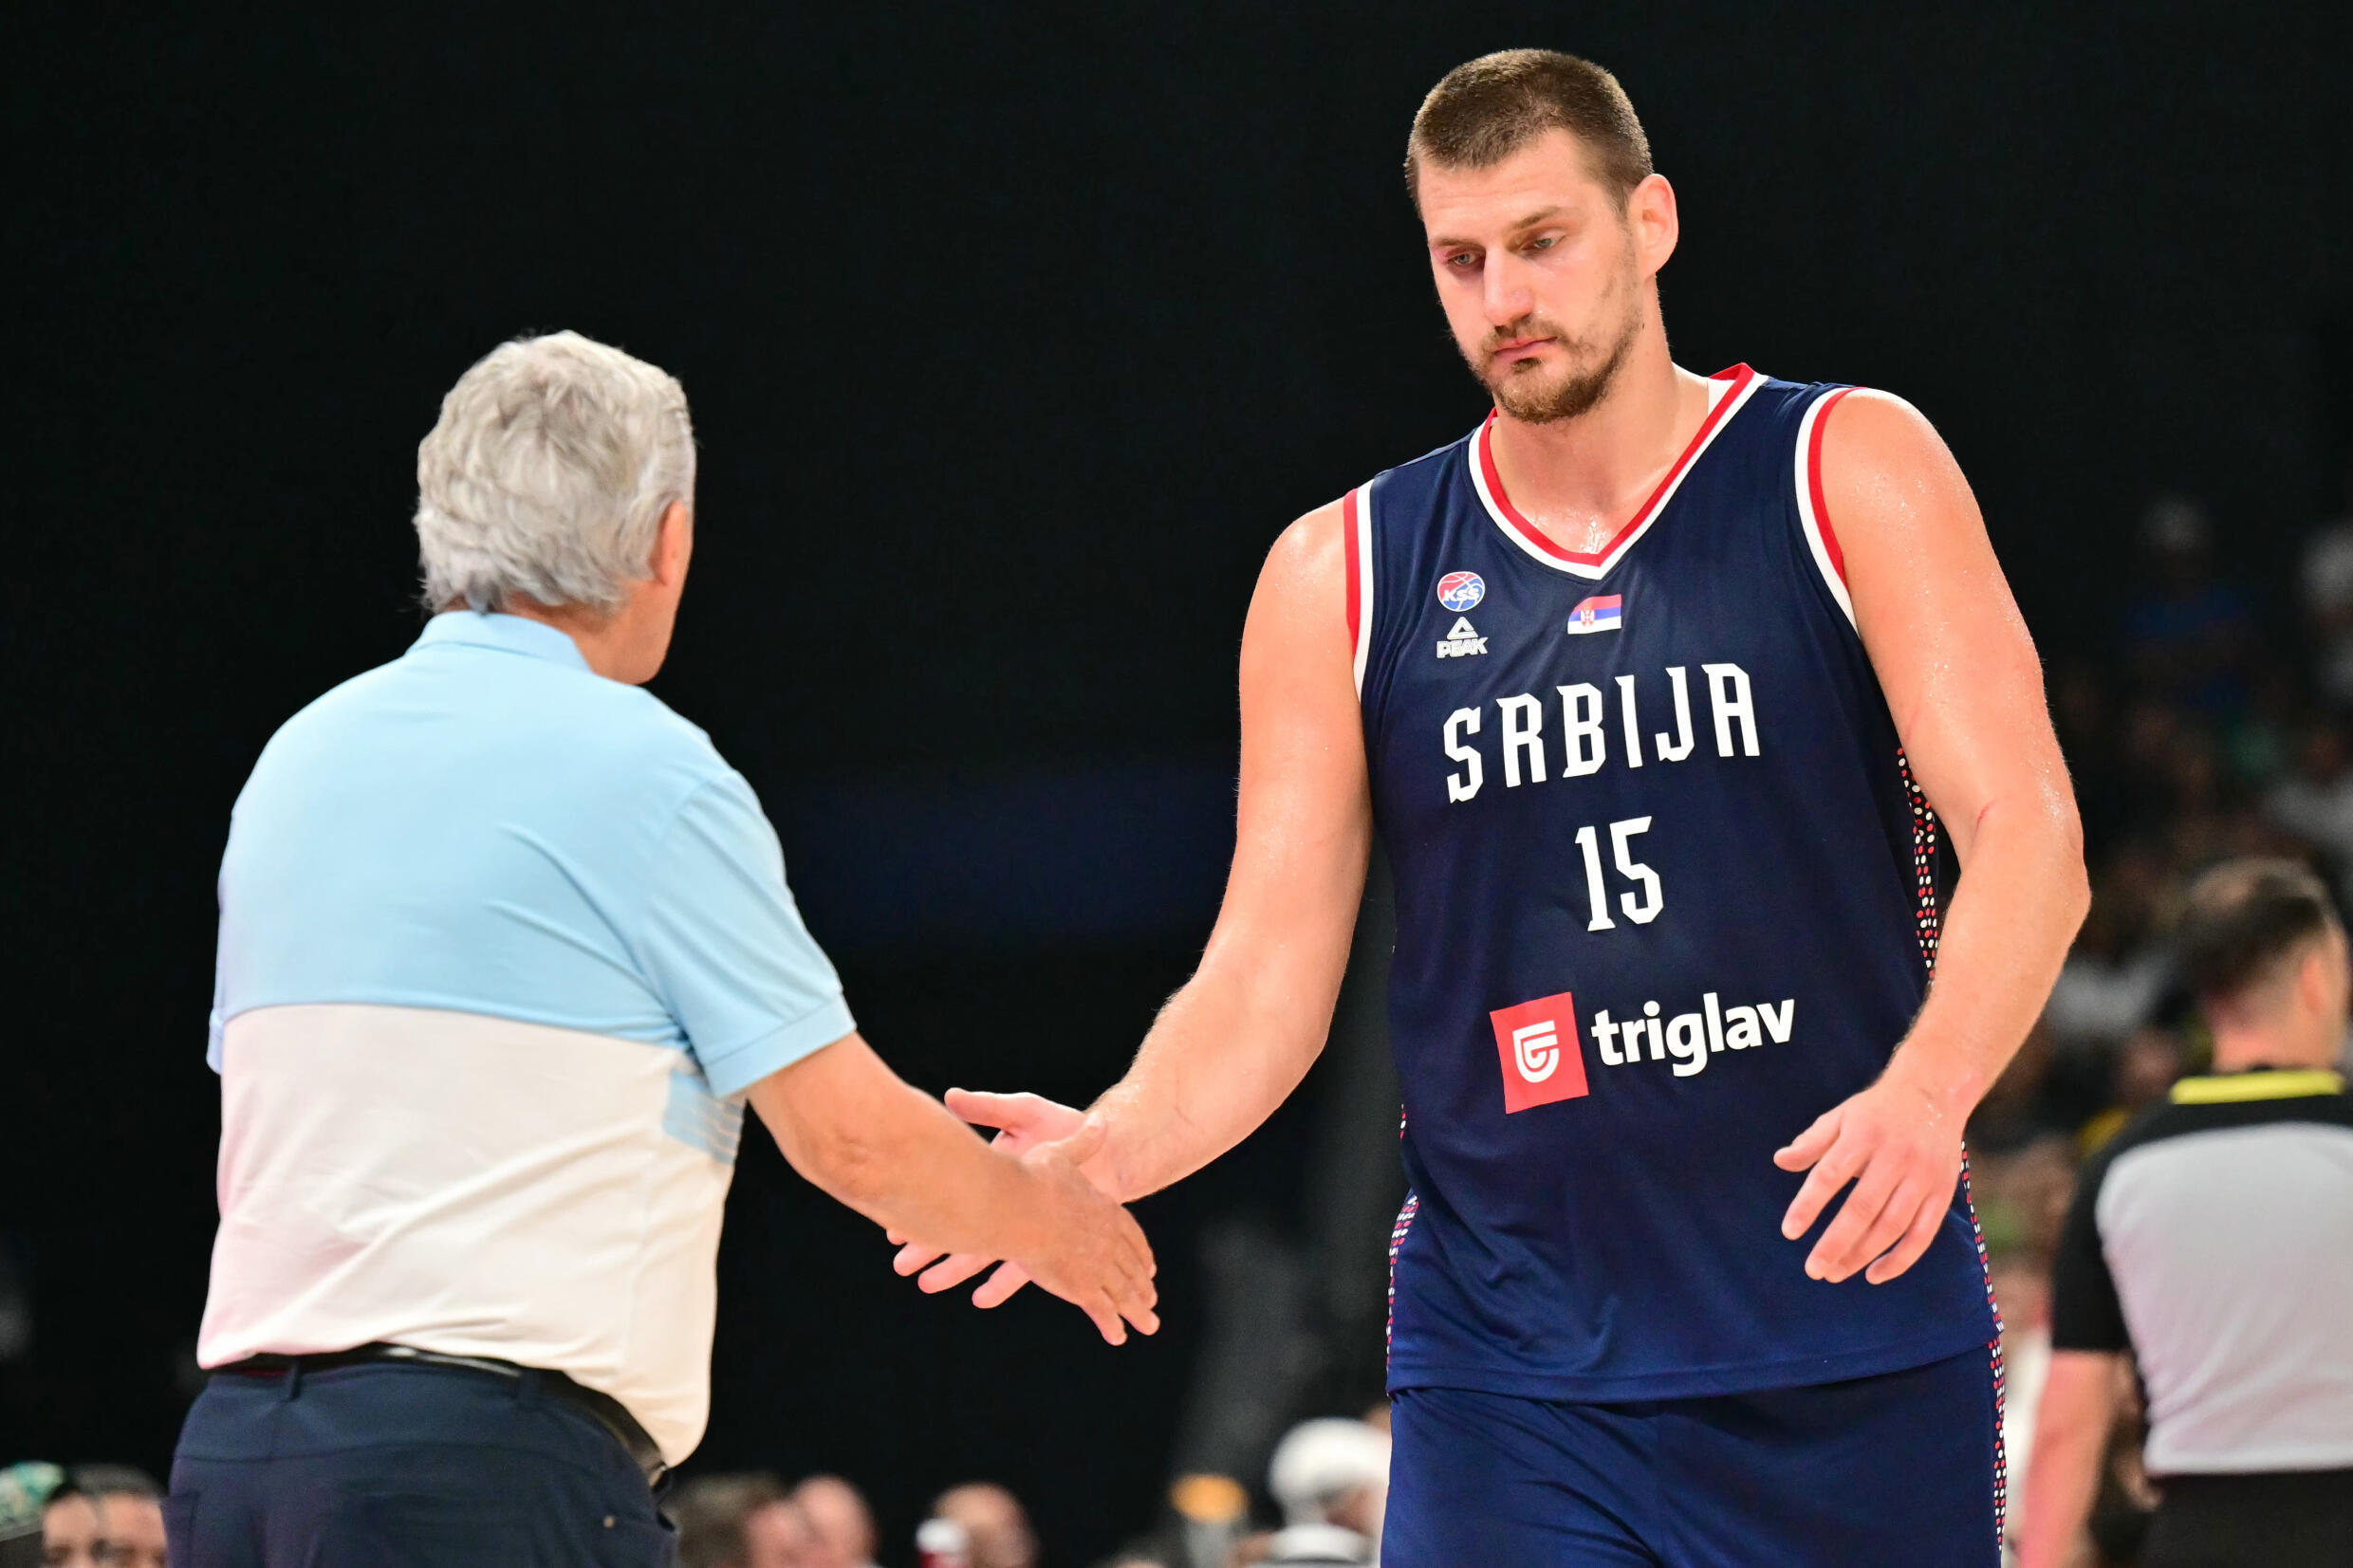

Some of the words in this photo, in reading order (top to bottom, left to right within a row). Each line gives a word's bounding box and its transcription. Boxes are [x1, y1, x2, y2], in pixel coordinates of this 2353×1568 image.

[1443, 588, 1480, 601] KSS
[1436, 637, 1489, 658] PEAK
[1443, 663, 1760, 803] SRBIJA
[1575, 816, 1663, 932] 15
[1591, 992, 1795, 1077] triglav
